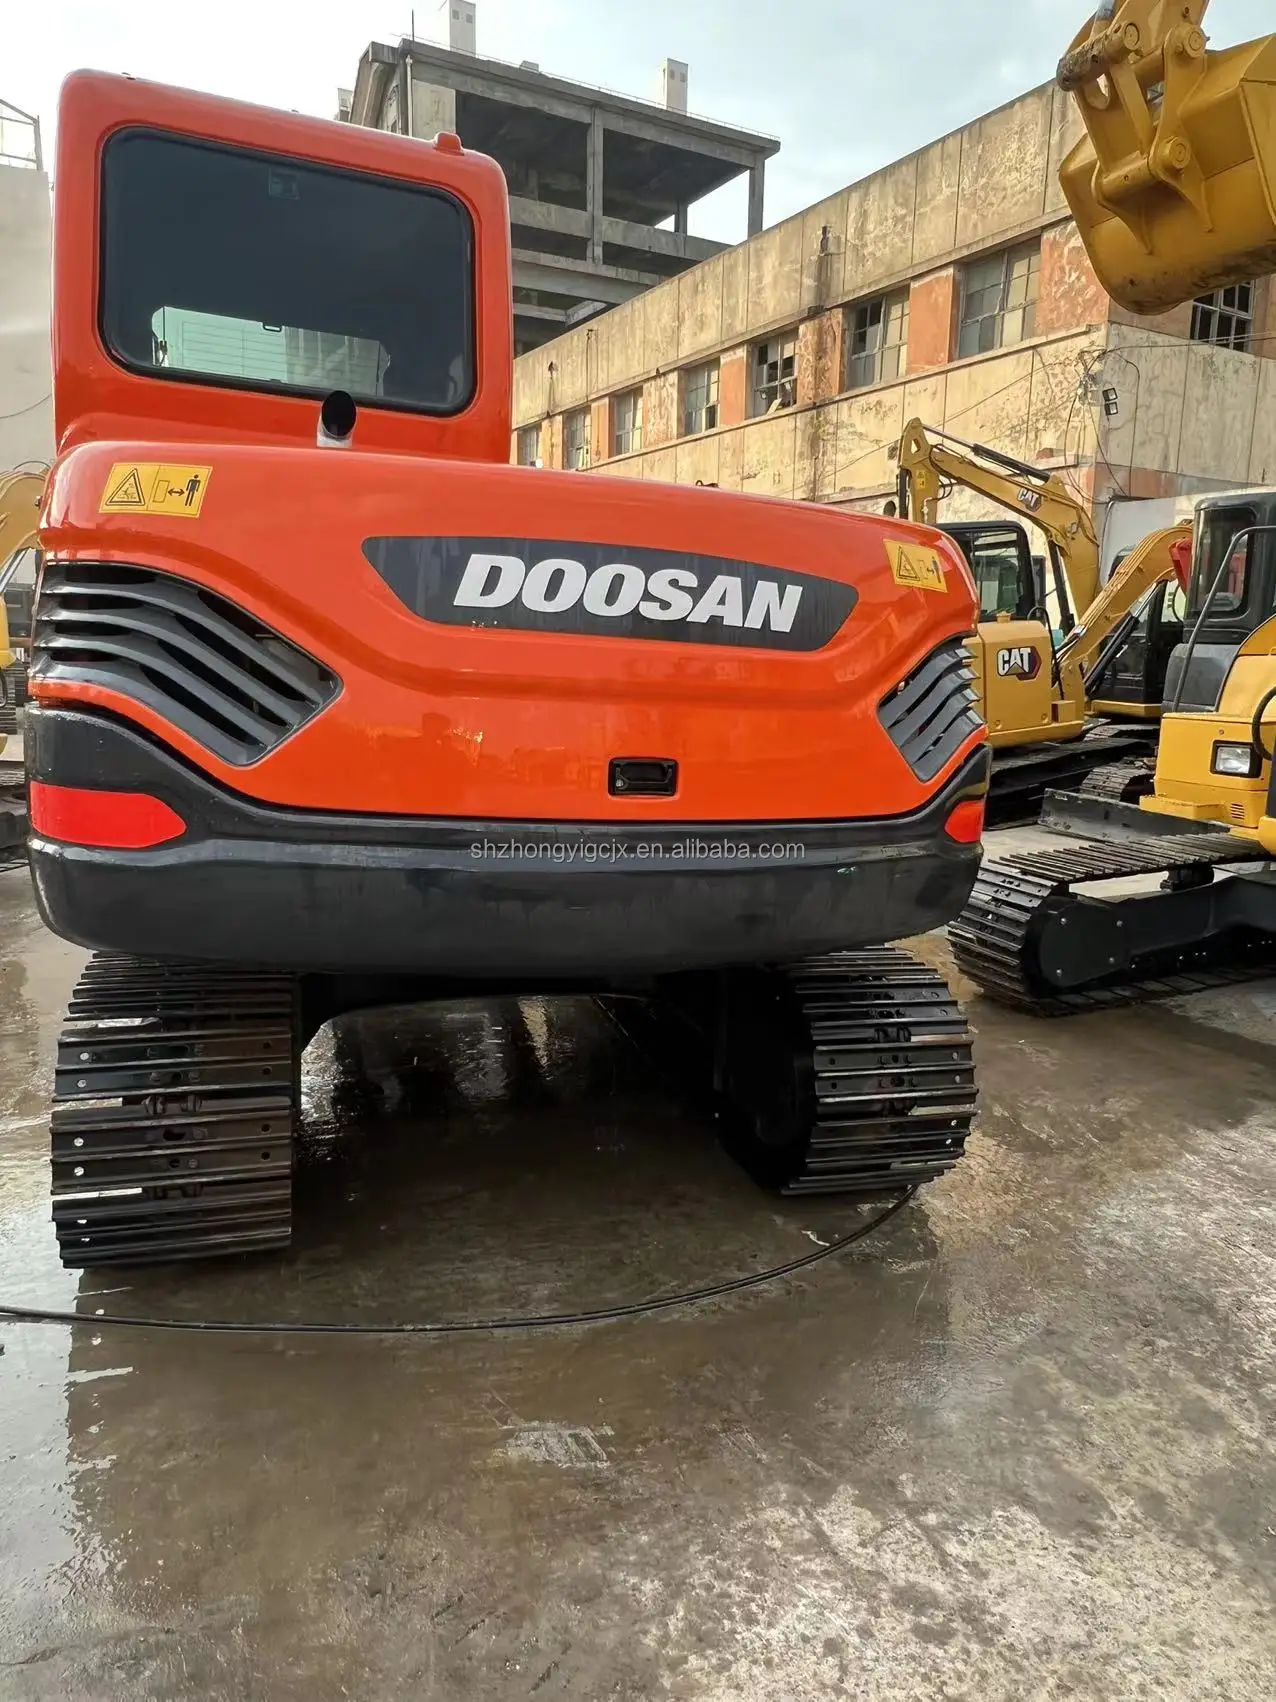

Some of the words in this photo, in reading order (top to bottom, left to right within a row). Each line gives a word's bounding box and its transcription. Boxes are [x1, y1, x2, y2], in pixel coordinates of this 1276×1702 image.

[1017, 487, 1040, 508] CAT
[453, 553, 803, 633] DOOSAN
[997, 647, 1031, 676] CAT
